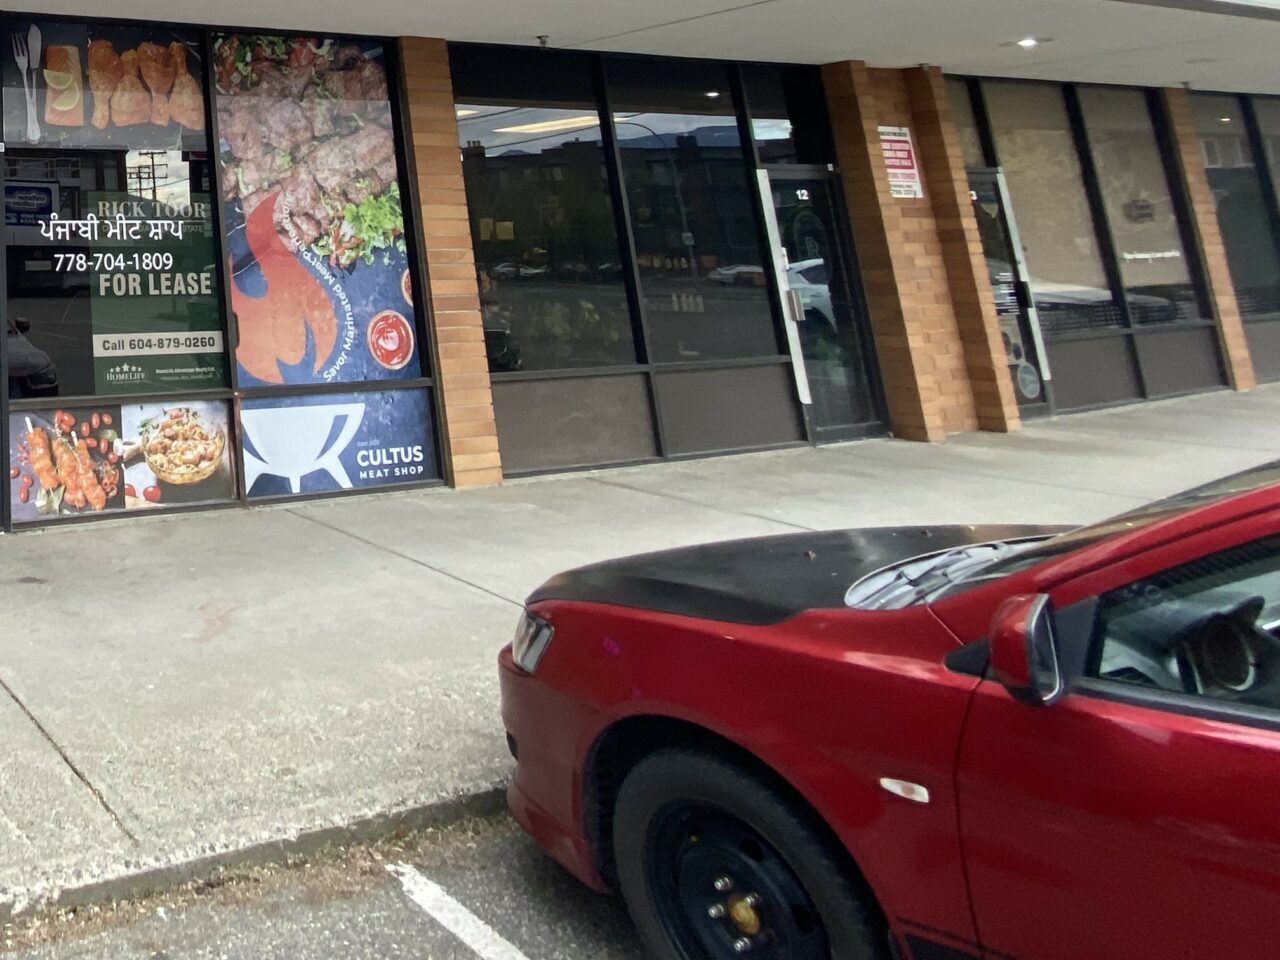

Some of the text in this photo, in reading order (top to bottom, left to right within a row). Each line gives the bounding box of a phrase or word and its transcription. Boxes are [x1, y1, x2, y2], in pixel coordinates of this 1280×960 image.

[796, 189, 810, 200] 12
[97, 201, 206, 218] RICK TOOR
[37, 212, 100, 240] ਪੰਜਾਬੀ
[106, 212, 143, 240] ਮੀਟ
[147, 219, 185, 240] ਸ਼ਾਪ
[53, 252, 174, 272] 778-704-1809
[99, 272, 212, 296] FOR LEASE
[332, 286, 355, 351] Marinated
[102, 336, 215, 351] Call 604-879-0260
[322, 352, 348, 382] Savor
[356, 445, 424, 467] CULTUS
[360, 465, 424, 479] MEAT SHOP
